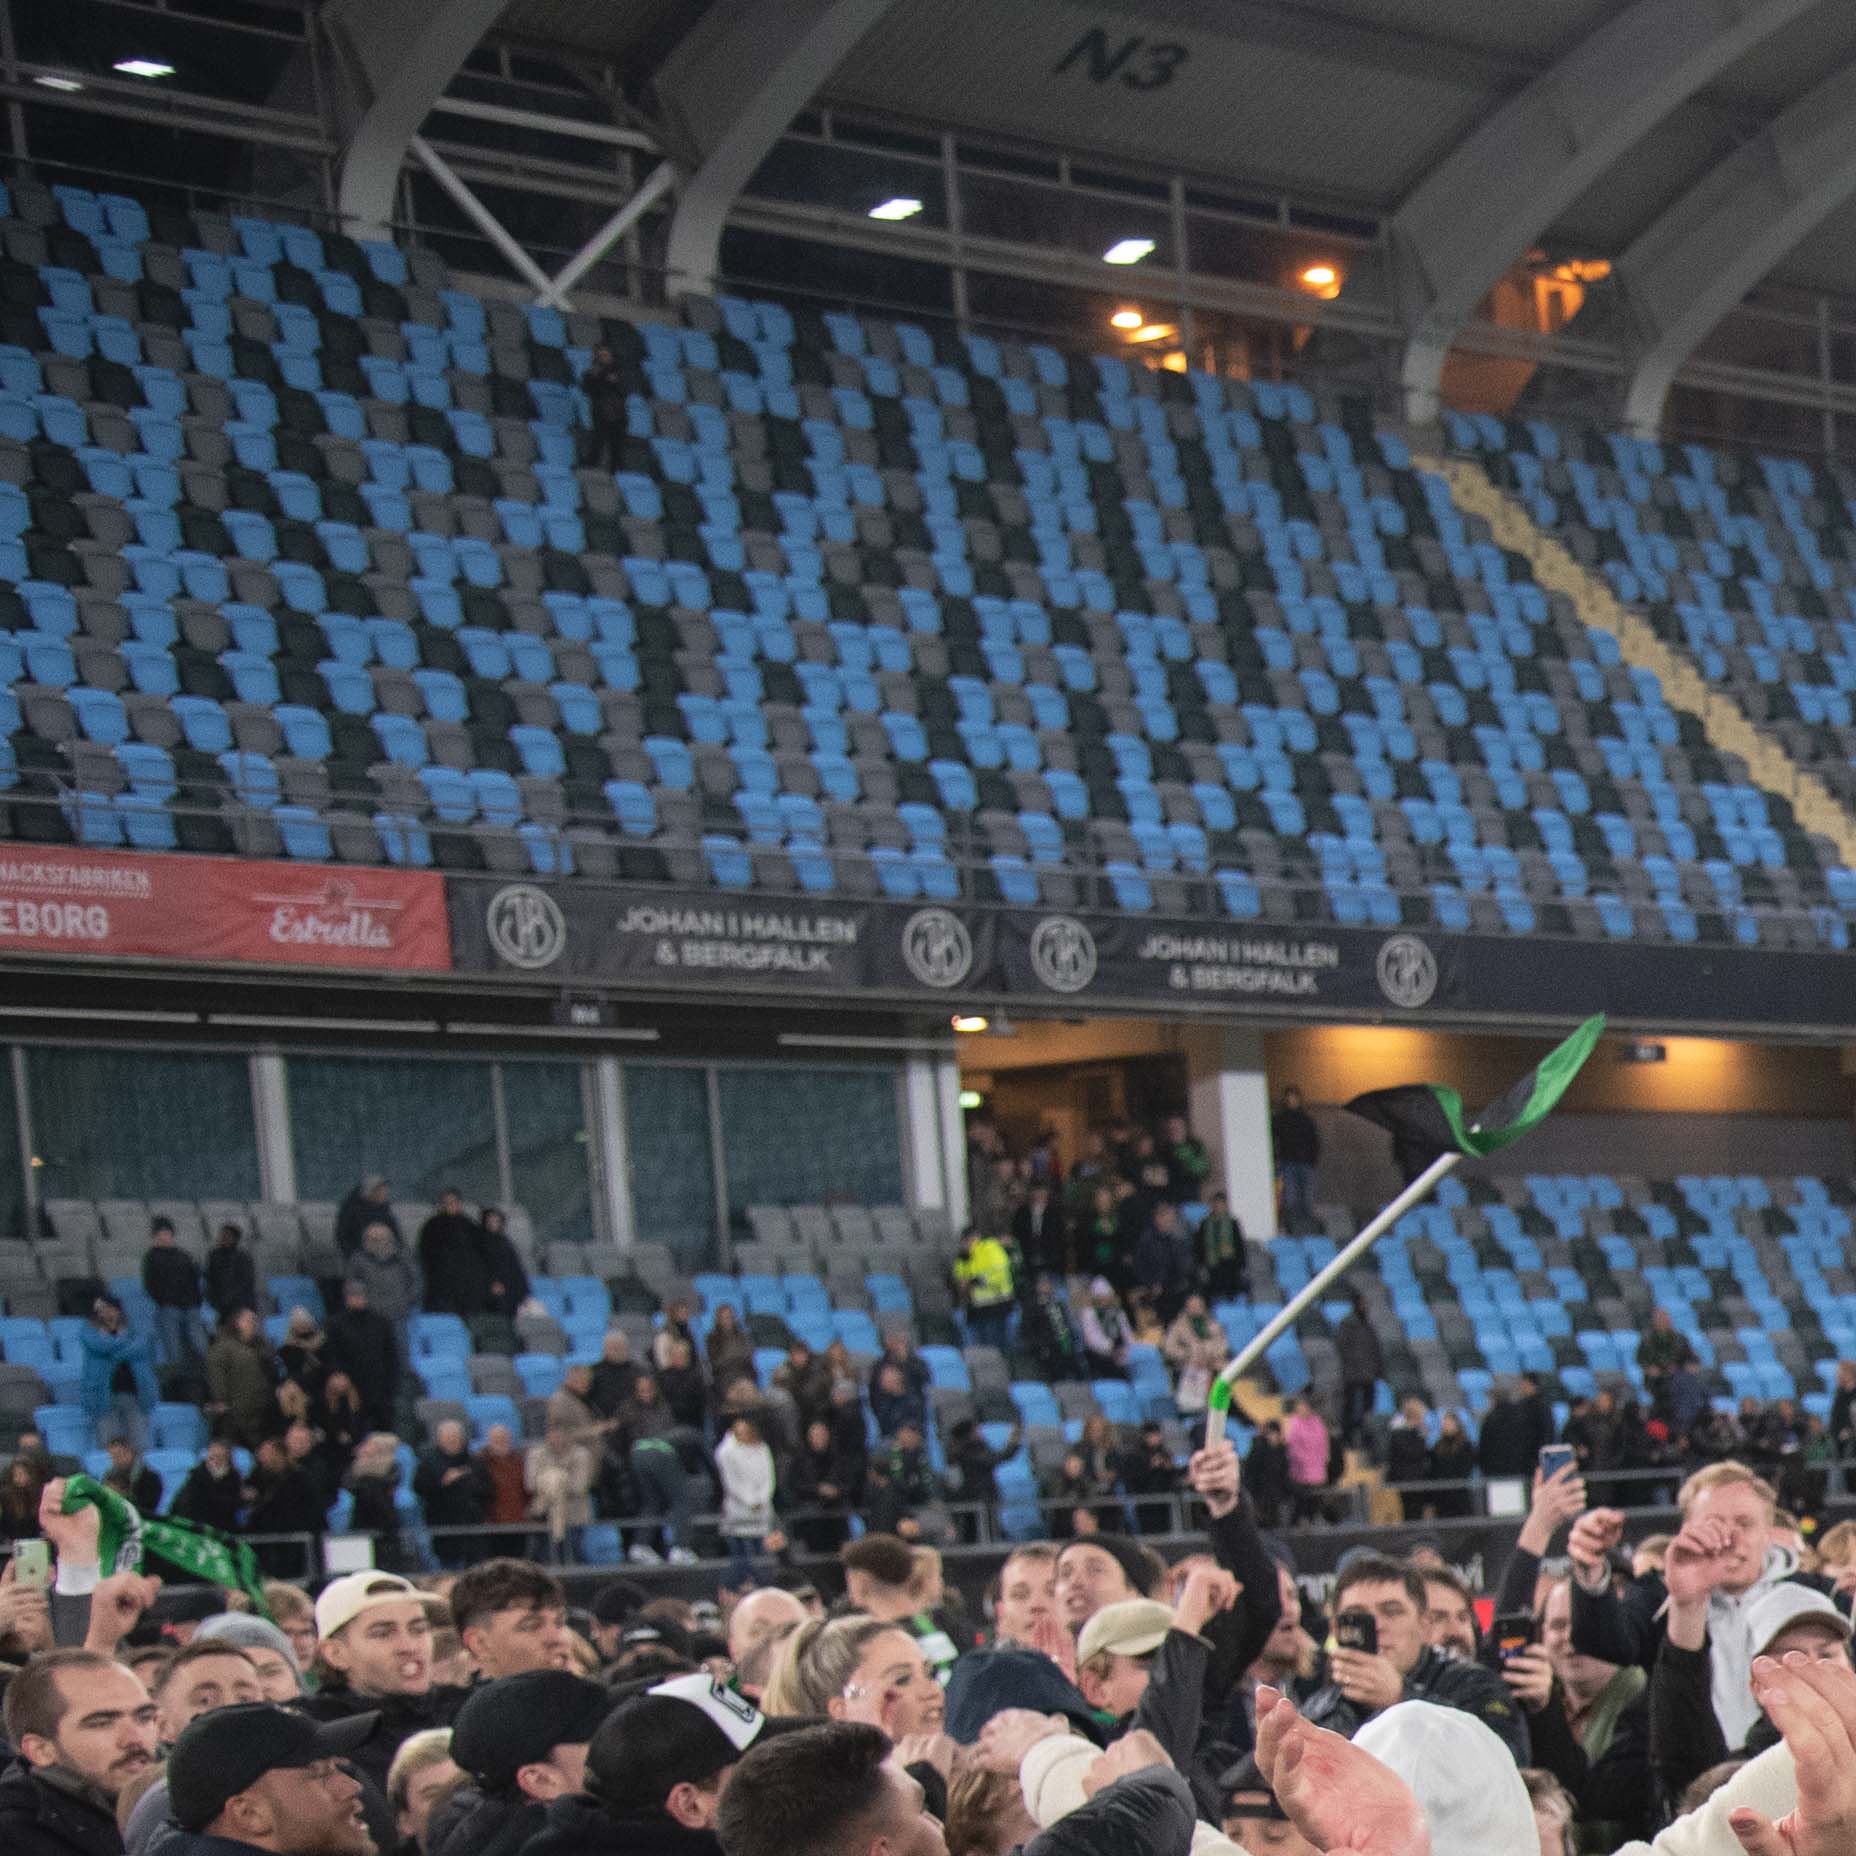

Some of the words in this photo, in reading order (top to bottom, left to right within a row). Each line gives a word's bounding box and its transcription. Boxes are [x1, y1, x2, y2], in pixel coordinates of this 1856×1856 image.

[1053, 26, 1188, 92] N3
[269, 904, 392, 947] Estrella
[616, 906, 725, 936] JOHAN
[742, 912, 857, 944] HALLEN
[656, 937, 679, 966] &
[681, 939, 832, 972] BERGFALK
[1136, 933, 1229, 961] JOHAN
[1242, 940, 1340, 968] HALLEN
[1191, 964, 1319, 994] BERGFALK
